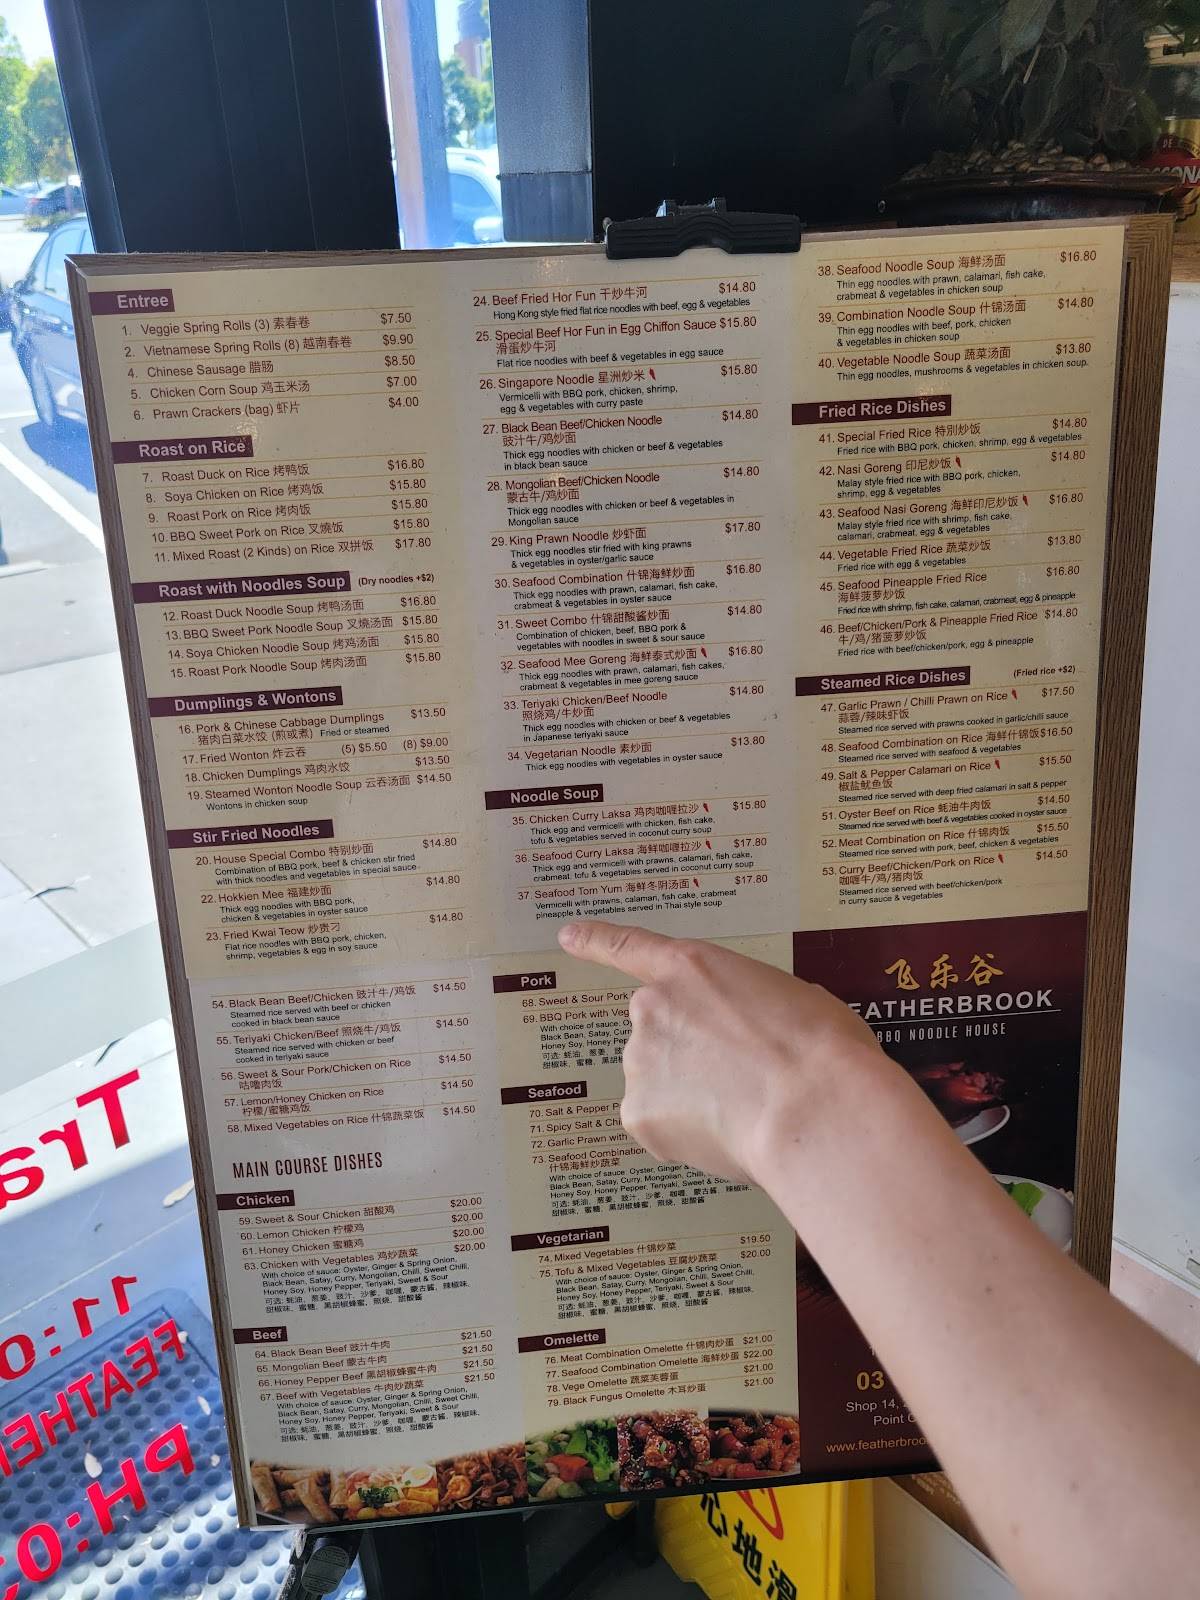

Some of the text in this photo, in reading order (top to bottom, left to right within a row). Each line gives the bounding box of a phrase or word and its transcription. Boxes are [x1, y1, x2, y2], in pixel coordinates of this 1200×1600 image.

[818, 250, 1096, 276] 38. Seafood Noodle Soup 海鲜汤面 $16.80
[117, 292, 169, 308] Entree
[473, 281, 755, 306] 24. Beef Fried Hor Fun 干炒牛河 $14.80
[836, 291, 876, 300] crabmeat
[880, 290, 885, 298] &
[888, 288, 934, 299] vegetables
[947, 286, 979, 294] chicken
[982, 285, 1002, 293] soup
[122, 312, 411, 336] 1. Veggie Spring Rolls (3) 素春卷 $7.50
[497, 359, 512, 367] Flat
[516, 358, 531, 366] rice
[534, 357, 567, 365] noodles
[590, 353, 608, 362] beef
[612, 353, 617, 361] &
[620, 351, 666, 362] vegetables
[669, 350, 676, 358] in
[679, 350, 695, 359] egg
[698, 348, 723, 356] sauce
[480, 364, 757, 389] 26. Singapore Noodle 星洲炒米 $15.80
[131, 376, 416, 399] 5. Chicken Corn Soup 鸡玉米汤 $7.00
[820, 398, 945, 417] Fried Rice Dishes
[139, 438, 246, 456] Roast on Rice
[142, 458, 424, 482] 7. Roast Duck on Rice 烤鸭饭 $16.80
[159, 576, 344, 596] Roast with Noodles Soup
[358, 573, 434, 586] (Dry noodles +$2)
[821, 671, 965, 689] Steamed Rice Dishes
[1014, 668, 1037, 678] (Fried
[1058, 665, 1075, 673] +$2)
[174, 692, 336, 711] Dumplings & Wontons
[508, 736, 764, 760] 34. Vegetarian Noodle 素炒面 $13.80
[185, 755, 449, 782] 18. Chicken Dumplings 鸡肉水饺 $13.50
[511, 788, 598, 802] Noodle Soup
[822, 811, 836, 820] 51.
[838, 810, 870, 820] Oyster
[873, 807, 896, 816] Beef
[914, 805, 934, 814] Rice
[938, 800, 990, 812] 蚝油牛肉饭
[1038, 794, 1069, 805] $14.50
[193, 825, 319, 843] Stir Fried Noodles
[206, 932, 221, 940] 23.
[223, 930, 248, 939] Fried
[252, 928, 276, 937] Kwai
[278, 927, 304, 935] Teow
[429, 912, 463, 923] $14.80
[521, 975, 551, 986] Pork
[884, 953, 1004, 990] 飞乐谷
[522, 992, 628, 1007] 68. Sweet & Sour Pork
[848, 989, 1053, 1019] EATHERBROOK
[876, 1023, 1006, 1043] BBQ NOODLE HOUSE
[528, 1084, 580, 1098] Seafood
[227, 1124, 241, 1132] 58.
[244, 1123, 272, 1131] Mixed
[275, 1119, 329, 1130] Vegetables
[346, 1116, 368, 1124] Rice
[371, 1109, 424, 1122] 什锦蔬菜饭
[443, 1105, 475, 1115] $14.50
[233, 1152, 382, 1178] MAIN COURSE DISHES
[236, 1194, 289, 1205] Chicken
[537, 1230, 603, 1245] Vegetarian
[253, 1329, 281, 1339] Beef
[270, 1349, 295, 1357] Black
[325, 1344, 346, 1353] Beef
[350, 1340, 390, 1351] 豉汁牛肉
[461, 1329, 491, 1340] $21.50
[544, 1333, 598, 1346] Omelette
[546, 1363, 773, 1392] 78. Vege Omelette 蔬菜芙蓉蛋 $21.00
[856, 1371, 885, 1391] 03
[846, 1402, 877, 1412] Shop
[873, 1414, 904, 1425] Point
[826, 1437, 928, 1452] www.featherbroo
